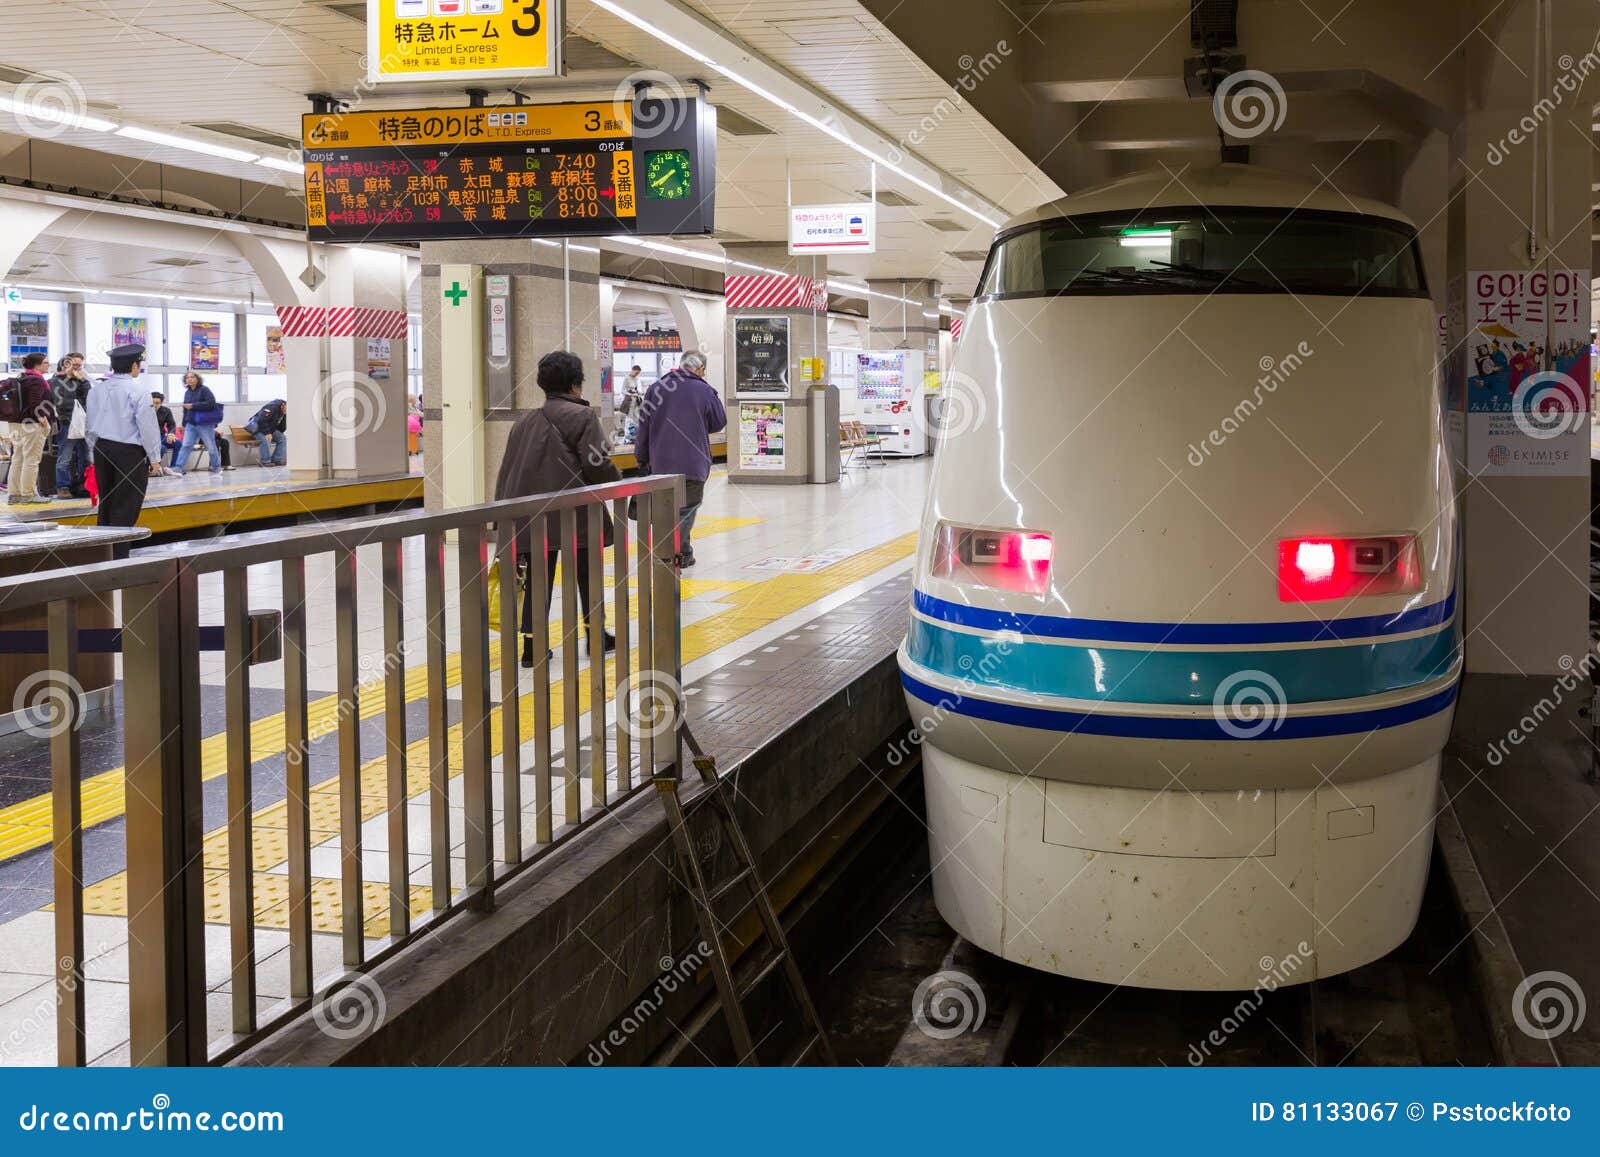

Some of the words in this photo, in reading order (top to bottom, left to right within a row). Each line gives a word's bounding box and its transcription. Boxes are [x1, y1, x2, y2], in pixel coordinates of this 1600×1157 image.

[511, 0, 541, 37] 3
[395, 20, 500, 44] 特急ホーム
[415, 44, 453, 56] Limited
[455, 44, 498, 55] Express
[378, 113, 486, 141] 特急のりば
[487, 128, 513, 138] L.T.D.
[515, 127, 552, 137] Express
[310, 152, 335, 162] のりば
[598, 141, 625, 151] のりば
[555, 154, 596, 169] 7:40
[363, 176, 392, 193] 館林
[406, 175, 449, 193] 足利市
[463, 174, 492, 190] 太田
[551, 170, 596, 187] 新桐生
[617, 159, 633, 209] 3番線
[308, 170, 324, 219] 4番線
[341, 194, 369, 209] 特急
[448, 188, 521, 206] 鬼怒川温泉
[558, 186, 598, 202] 8:00
[343, 207, 414, 225] 特急りょうもう
[559, 202, 599, 218] 8:40
[1477, 273, 1580, 298] GO!GO!
